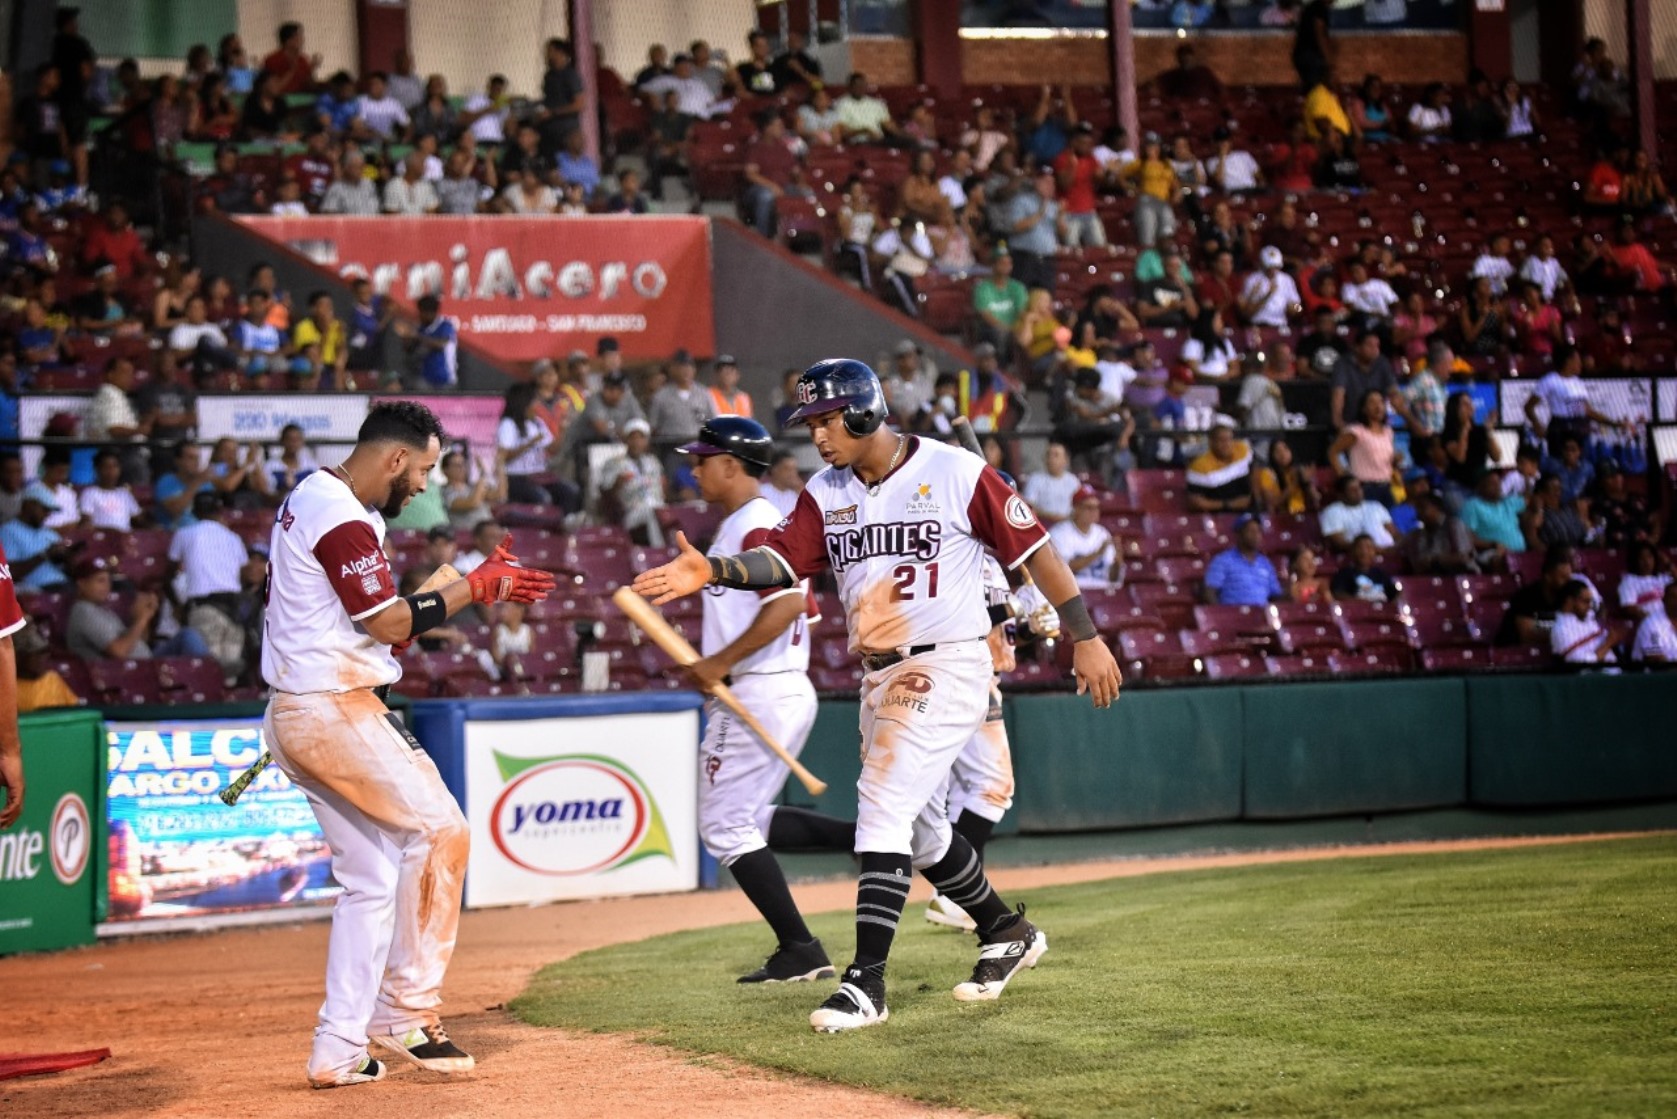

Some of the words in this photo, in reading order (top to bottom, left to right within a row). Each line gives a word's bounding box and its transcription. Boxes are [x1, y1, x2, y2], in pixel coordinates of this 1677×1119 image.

[825, 519, 942, 573] GIGANTES
[893, 562, 939, 601] 21
[508, 796, 624, 834] yoma
